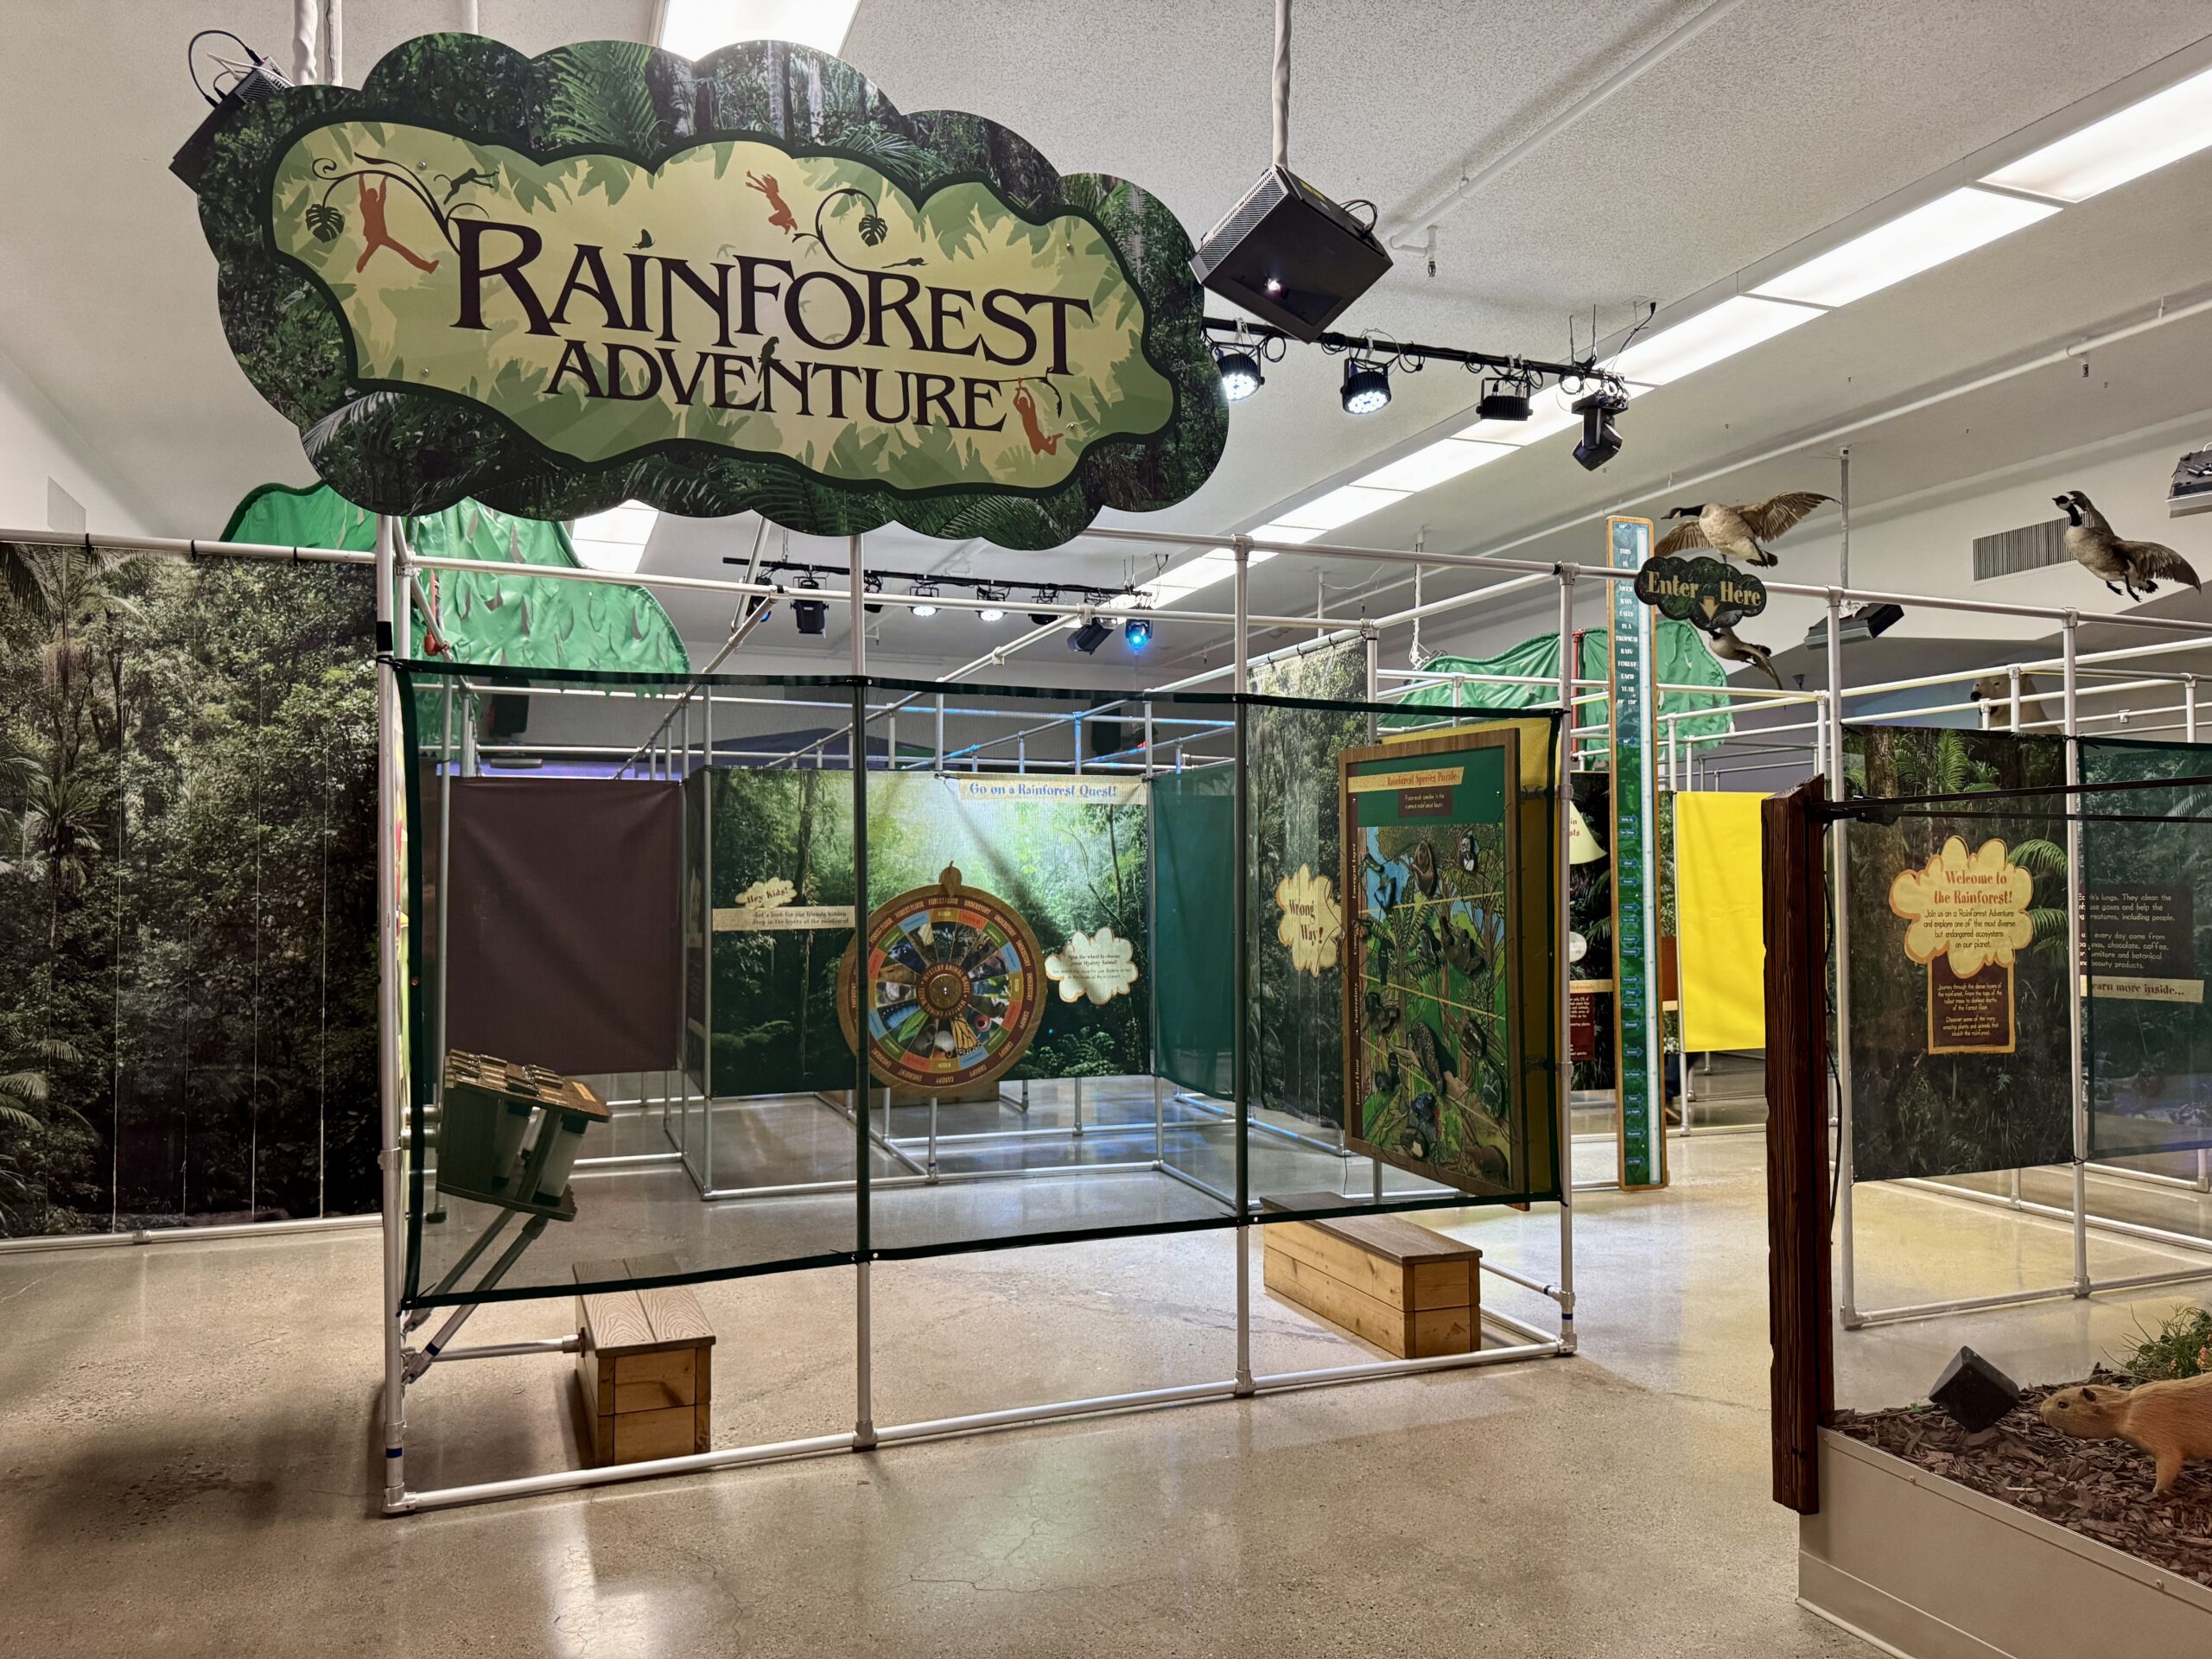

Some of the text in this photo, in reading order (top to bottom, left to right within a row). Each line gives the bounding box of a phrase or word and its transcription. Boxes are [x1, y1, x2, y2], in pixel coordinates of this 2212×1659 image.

[448, 218, 1094, 376] RAINFOREST
[543, 339, 1007, 432] ADVENTURE
[1646, 570, 1761, 605] Enter Here
[1387, 771, 1457, 785] Rainforest Species Puzzle
[969, 782, 987, 793] Go
[1018, 783, 1075, 795] Rainforest
[1079, 785, 1116, 797] Quest!
[1945, 870, 2006, 884] Welcome to
[747, 887, 789, 904] Hey Kids!
[1935, 890, 2012, 904] the Rainforest!
[2121, 893, 2139, 902] They
[1288, 899, 1315, 925] Wrong
[1924, 908, 1936, 918] Join
[1959, 908, 1986, 917] Rainforest
[2136, 902, 2150, 912] help
[1935, 919, 1953, 929] explore
[1965, 918, 1972, 927] of
[1300, 925, 1324, 945] Way!
[1946, 930, 1974, 939] endangered
[2114, 931, 2126, 940] day
[1974, 939, 1991, 949] planet.
[2107, 941, 2140, 950] chocolate,
[2143, 942, 2169, 950] coffee,
[2132, 952, 2162, 961] botanical
[2116, 983, 2184, 995] more inside...
